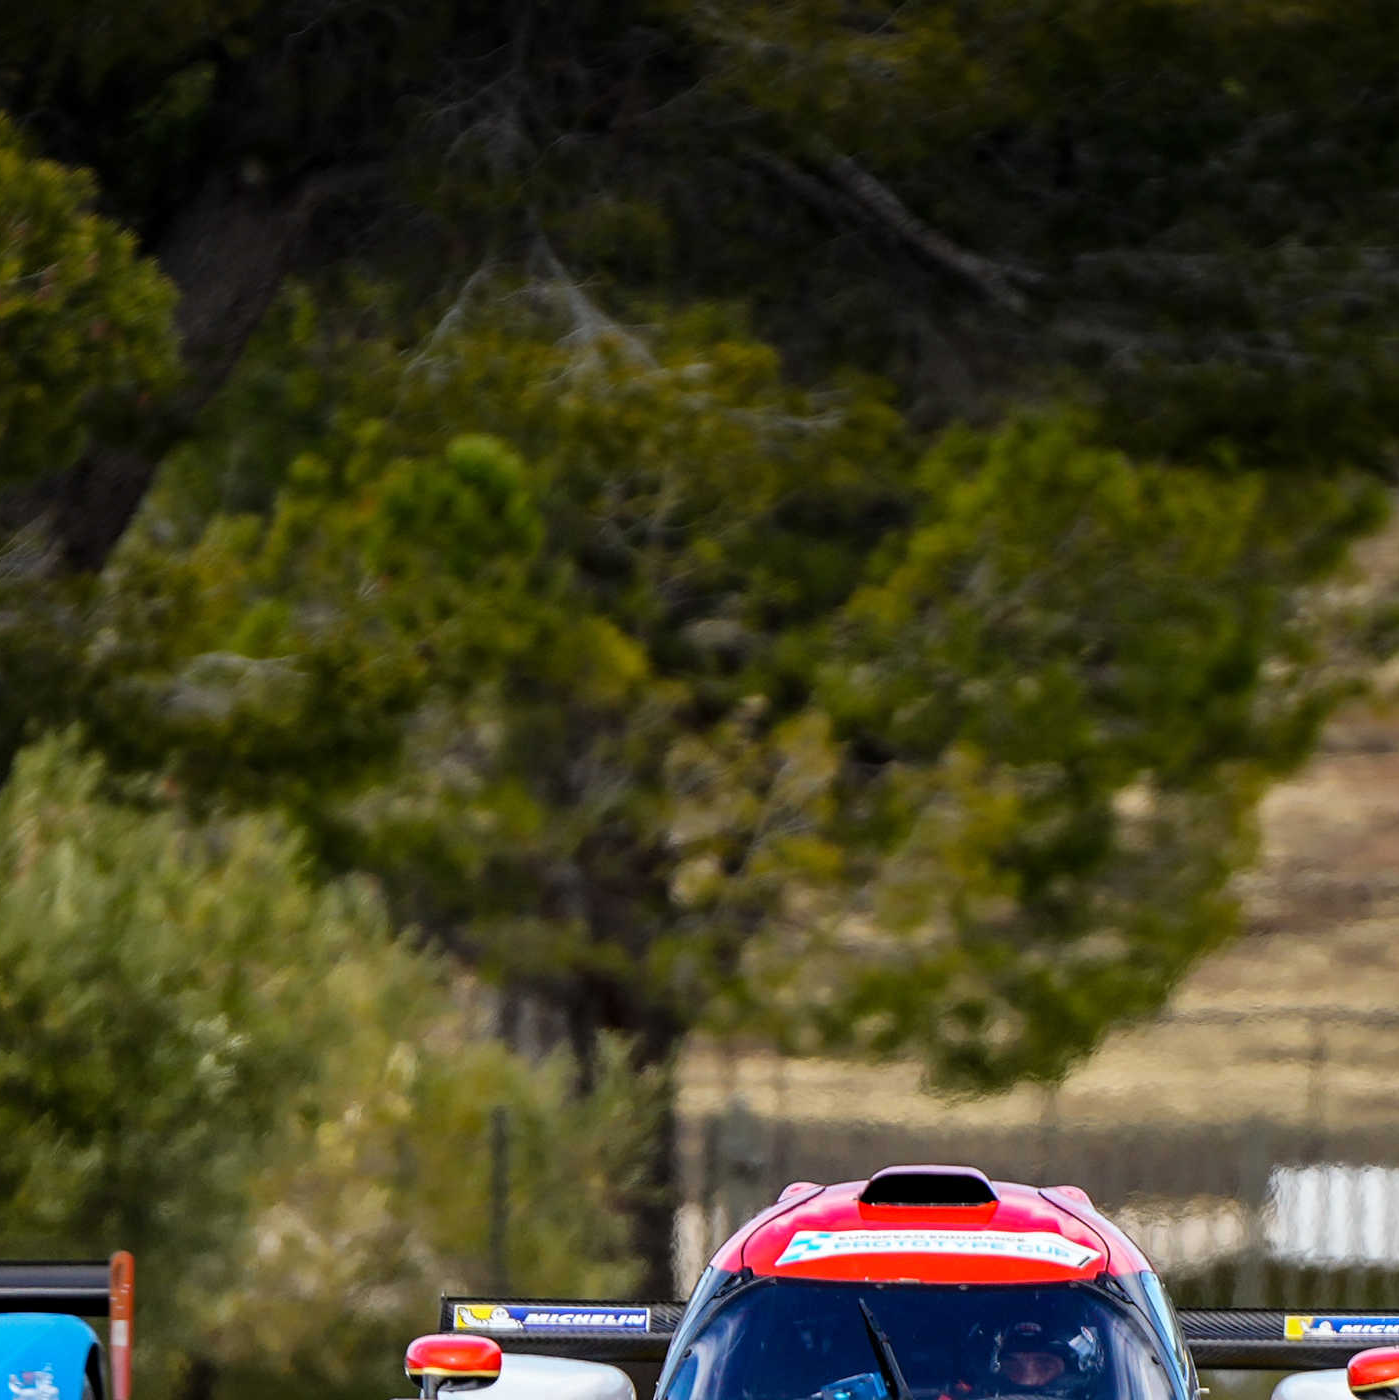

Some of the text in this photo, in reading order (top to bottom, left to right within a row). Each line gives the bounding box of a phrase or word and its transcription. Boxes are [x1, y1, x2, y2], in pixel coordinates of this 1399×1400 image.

[833, 1239, 1071, 1258] PROTOTYPE CUP
[523, 1313, 647, 1326] MICHELIN
